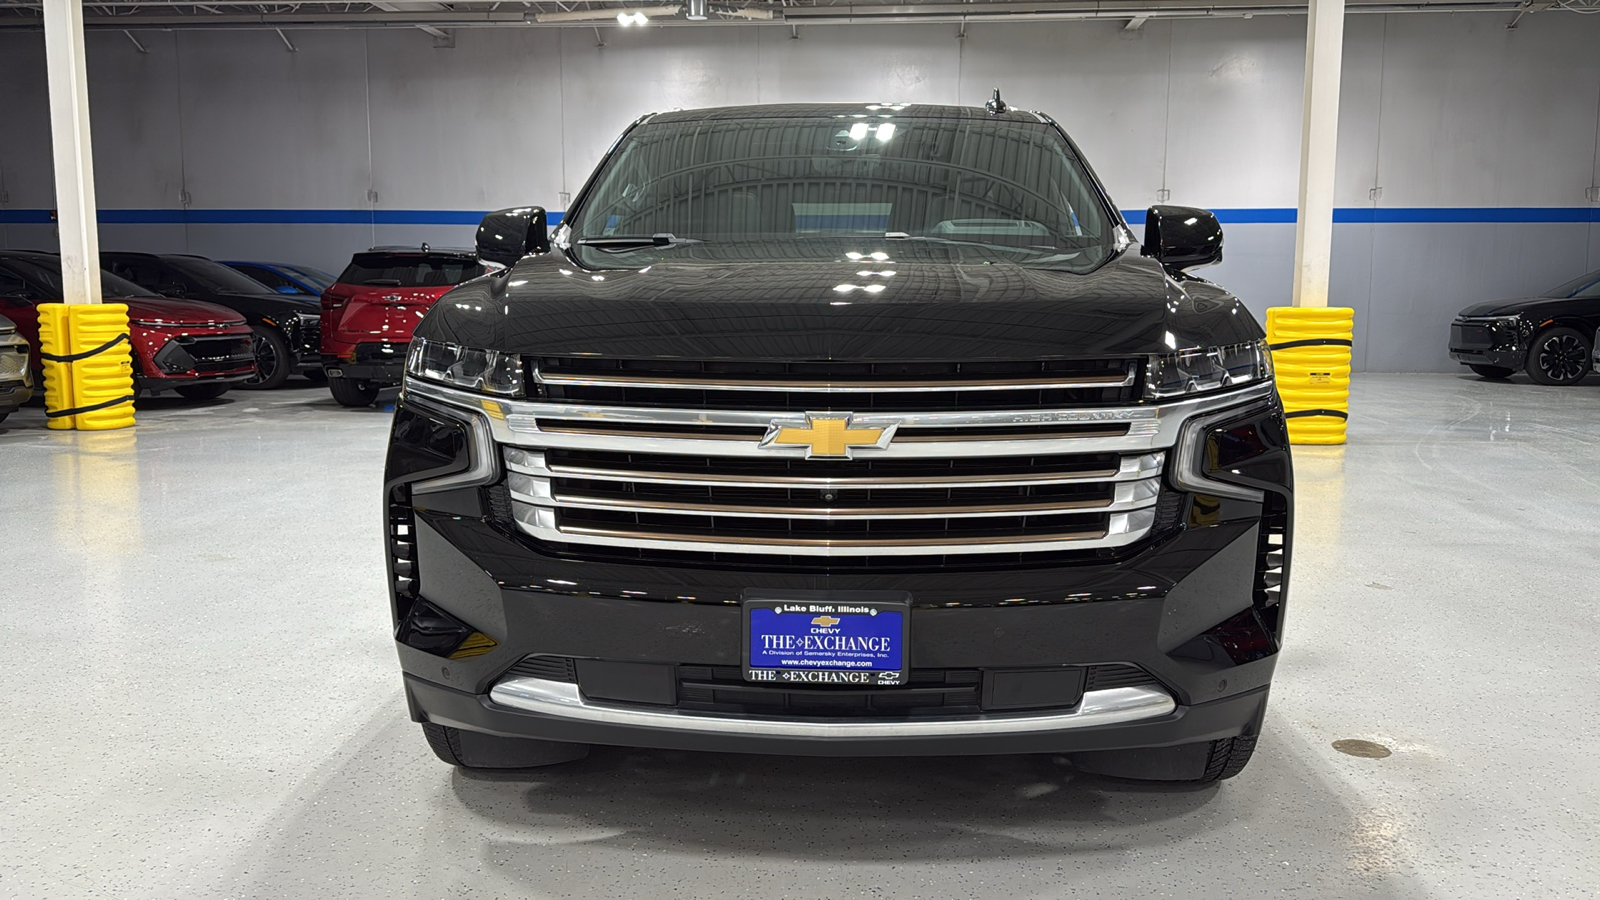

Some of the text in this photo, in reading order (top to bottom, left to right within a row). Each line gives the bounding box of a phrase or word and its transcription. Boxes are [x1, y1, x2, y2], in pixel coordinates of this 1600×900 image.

[784, 604, 870, 613] Lake Bluff, Illinois
[761, 634, 891, 652] THE EXCHANGE
[781, 659, 873, 668] www.chevyexchange.com
[749, 670, 870, 683] THE EXCHANGE
